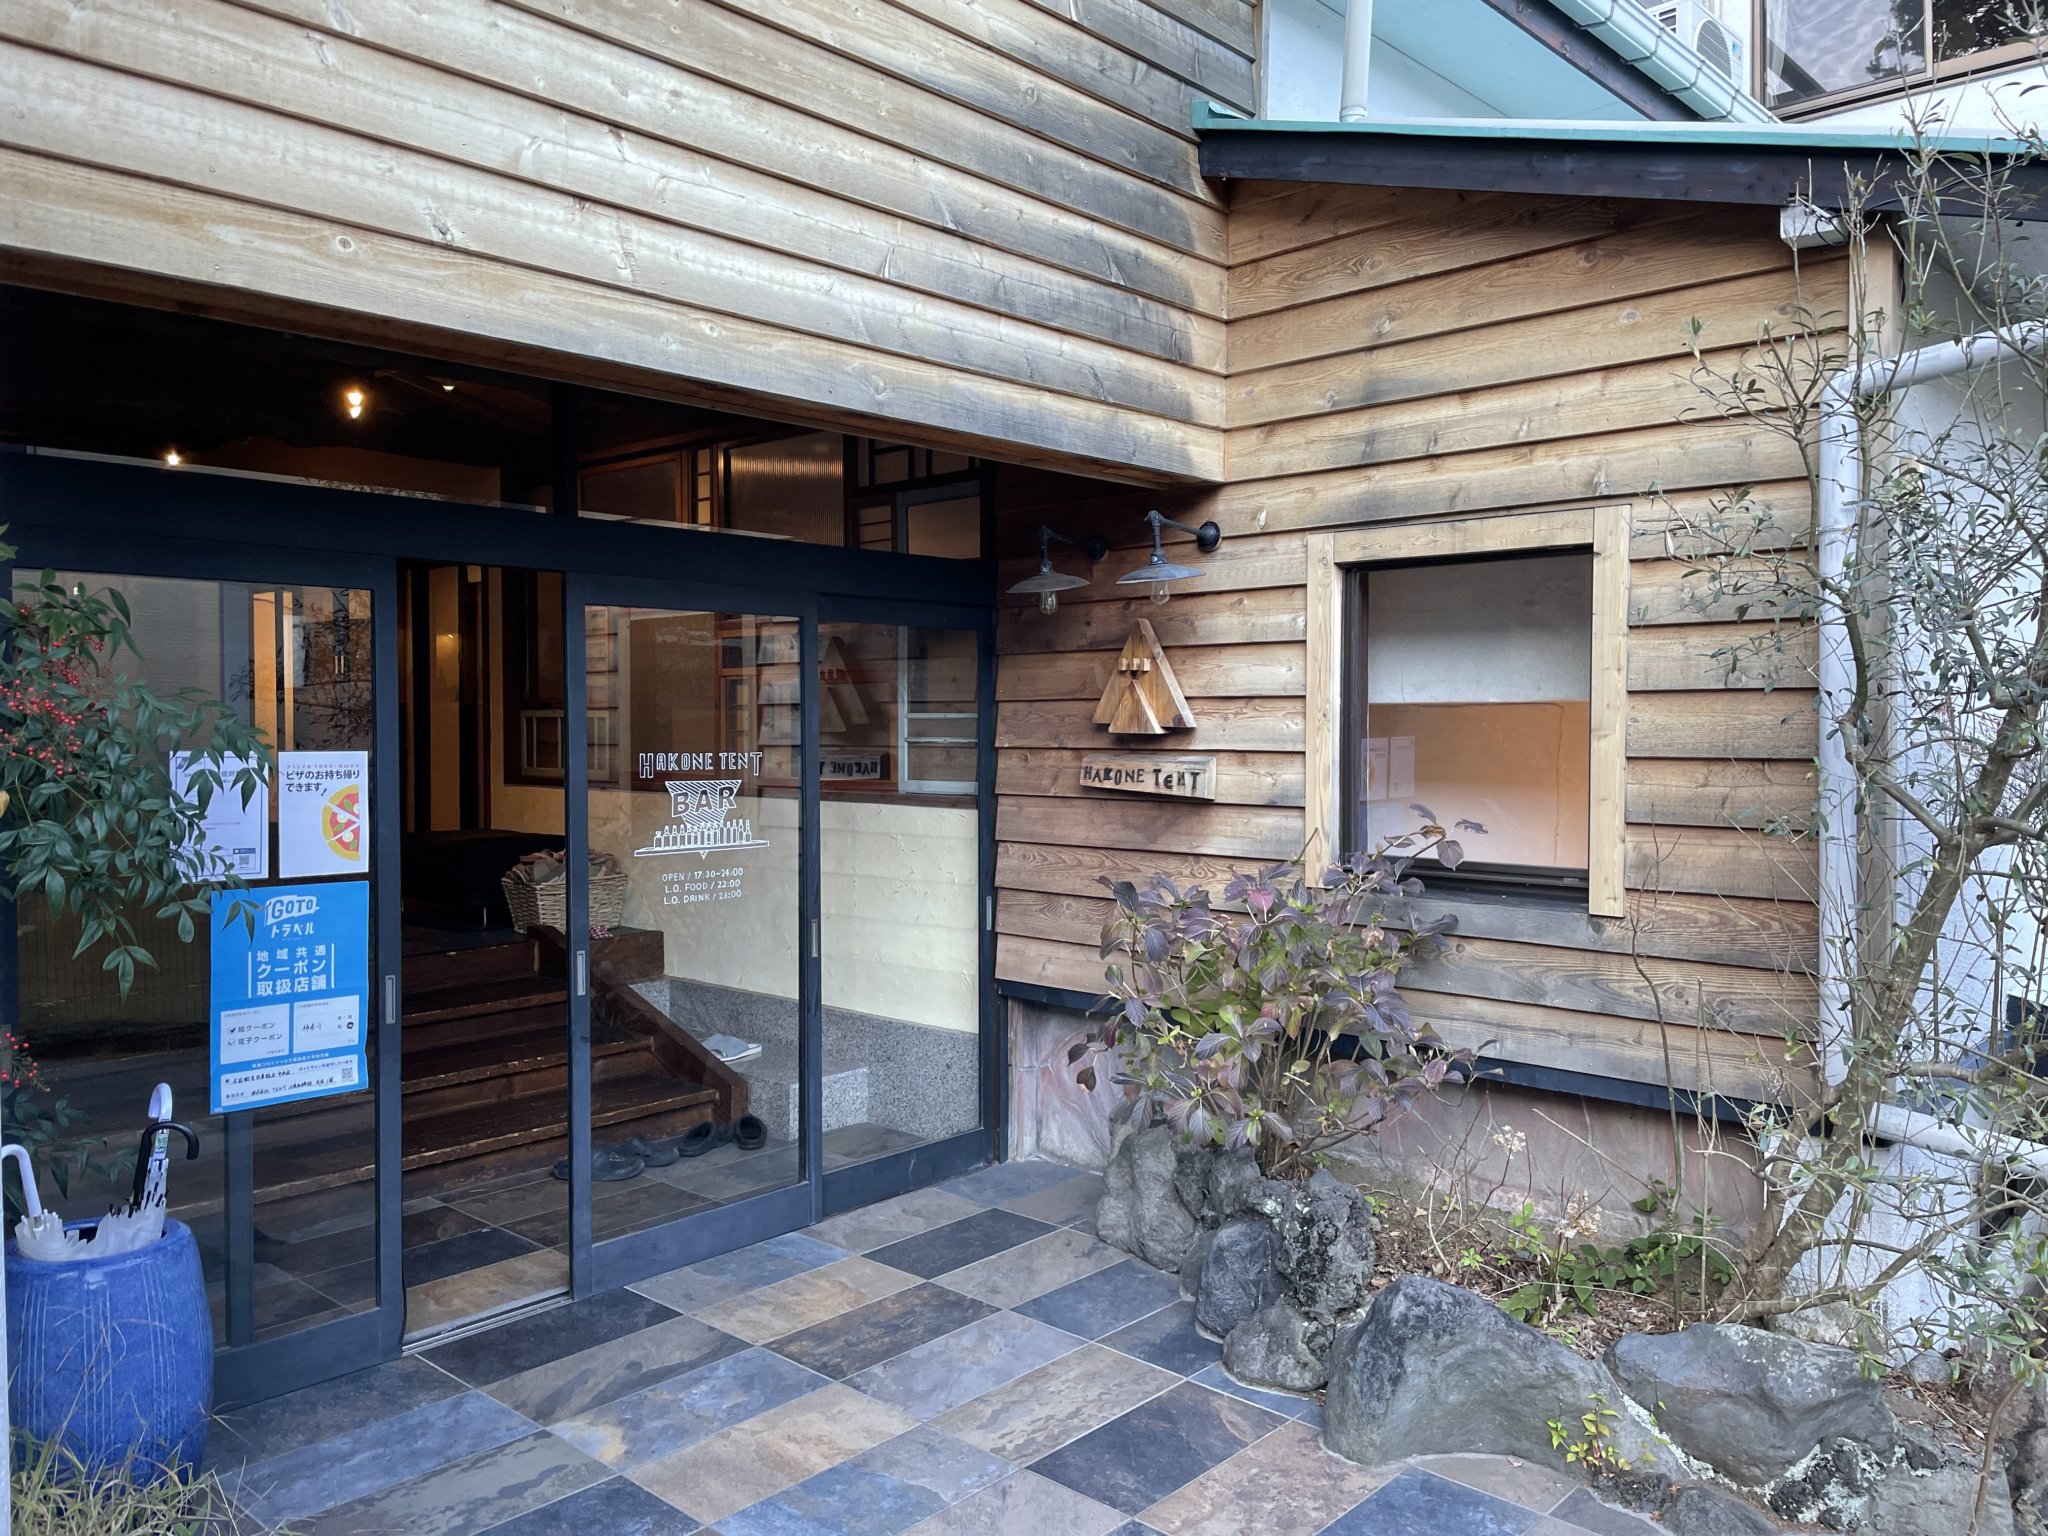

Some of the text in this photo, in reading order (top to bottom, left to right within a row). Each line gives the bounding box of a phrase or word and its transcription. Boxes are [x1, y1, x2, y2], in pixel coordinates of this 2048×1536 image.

[639, 752, 763, 779] HAKONE TENT
[1083, 765, 1145, 786] HAKONE
[671, 785, 737, 818] BAR
[661, 872, 685, 883] OPEN
[664, 883, 682, 893] L.O.
[685, 881, 708, 891] FOOD
[717, 879, 741, 889] 22:00
[663, 895, 681, 905] L.O.
[683, 893, 710, 904] DRINK
[719, 890, 742, 900] 23:00
[271, 922, 315, 938] トラベル
[257, 959, 327, 979] クーポン
[256, 974, 327, 997] 取扱店舗
